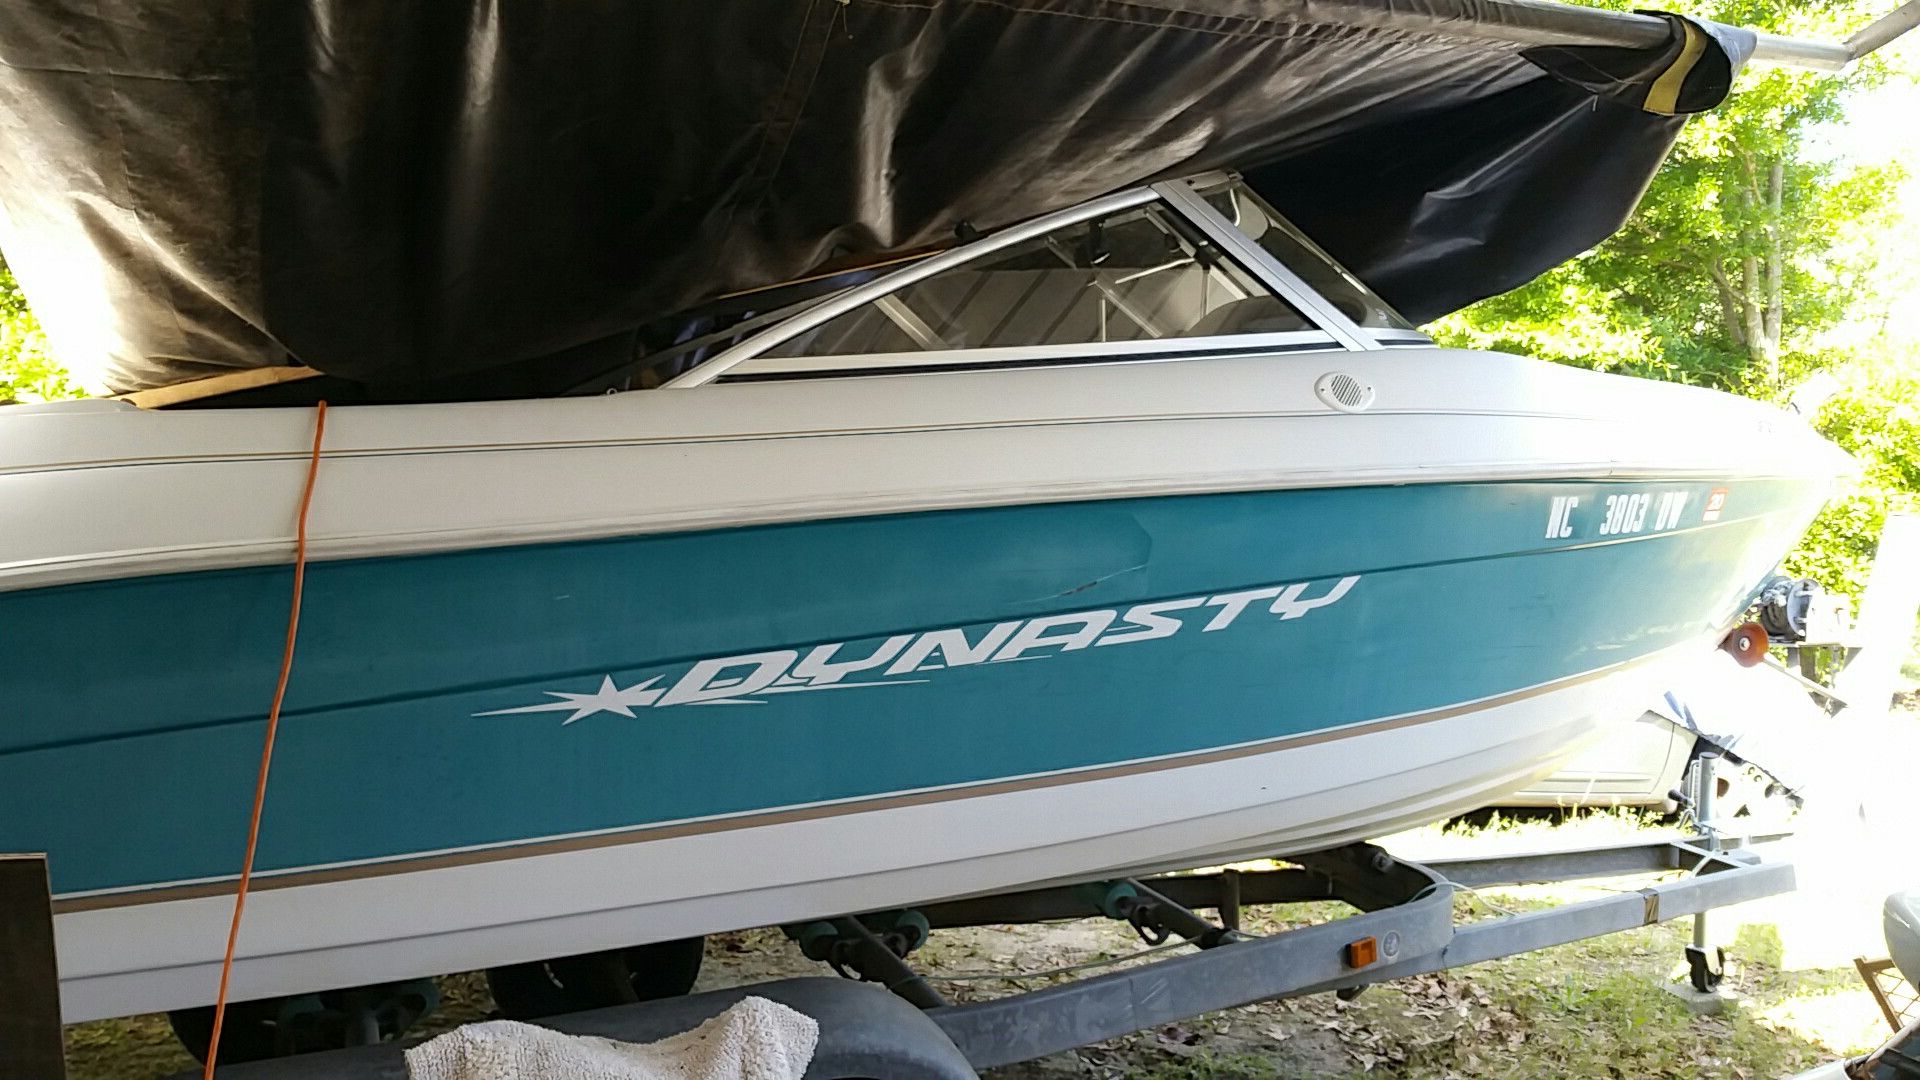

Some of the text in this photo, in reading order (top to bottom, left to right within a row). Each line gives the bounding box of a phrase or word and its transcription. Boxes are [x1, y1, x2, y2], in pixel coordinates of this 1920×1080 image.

[1545, 496, 1579, 538] NC
[1600, 493, 1649, 535] 3803
[653, 575, 1362, 708] DYNASTY
